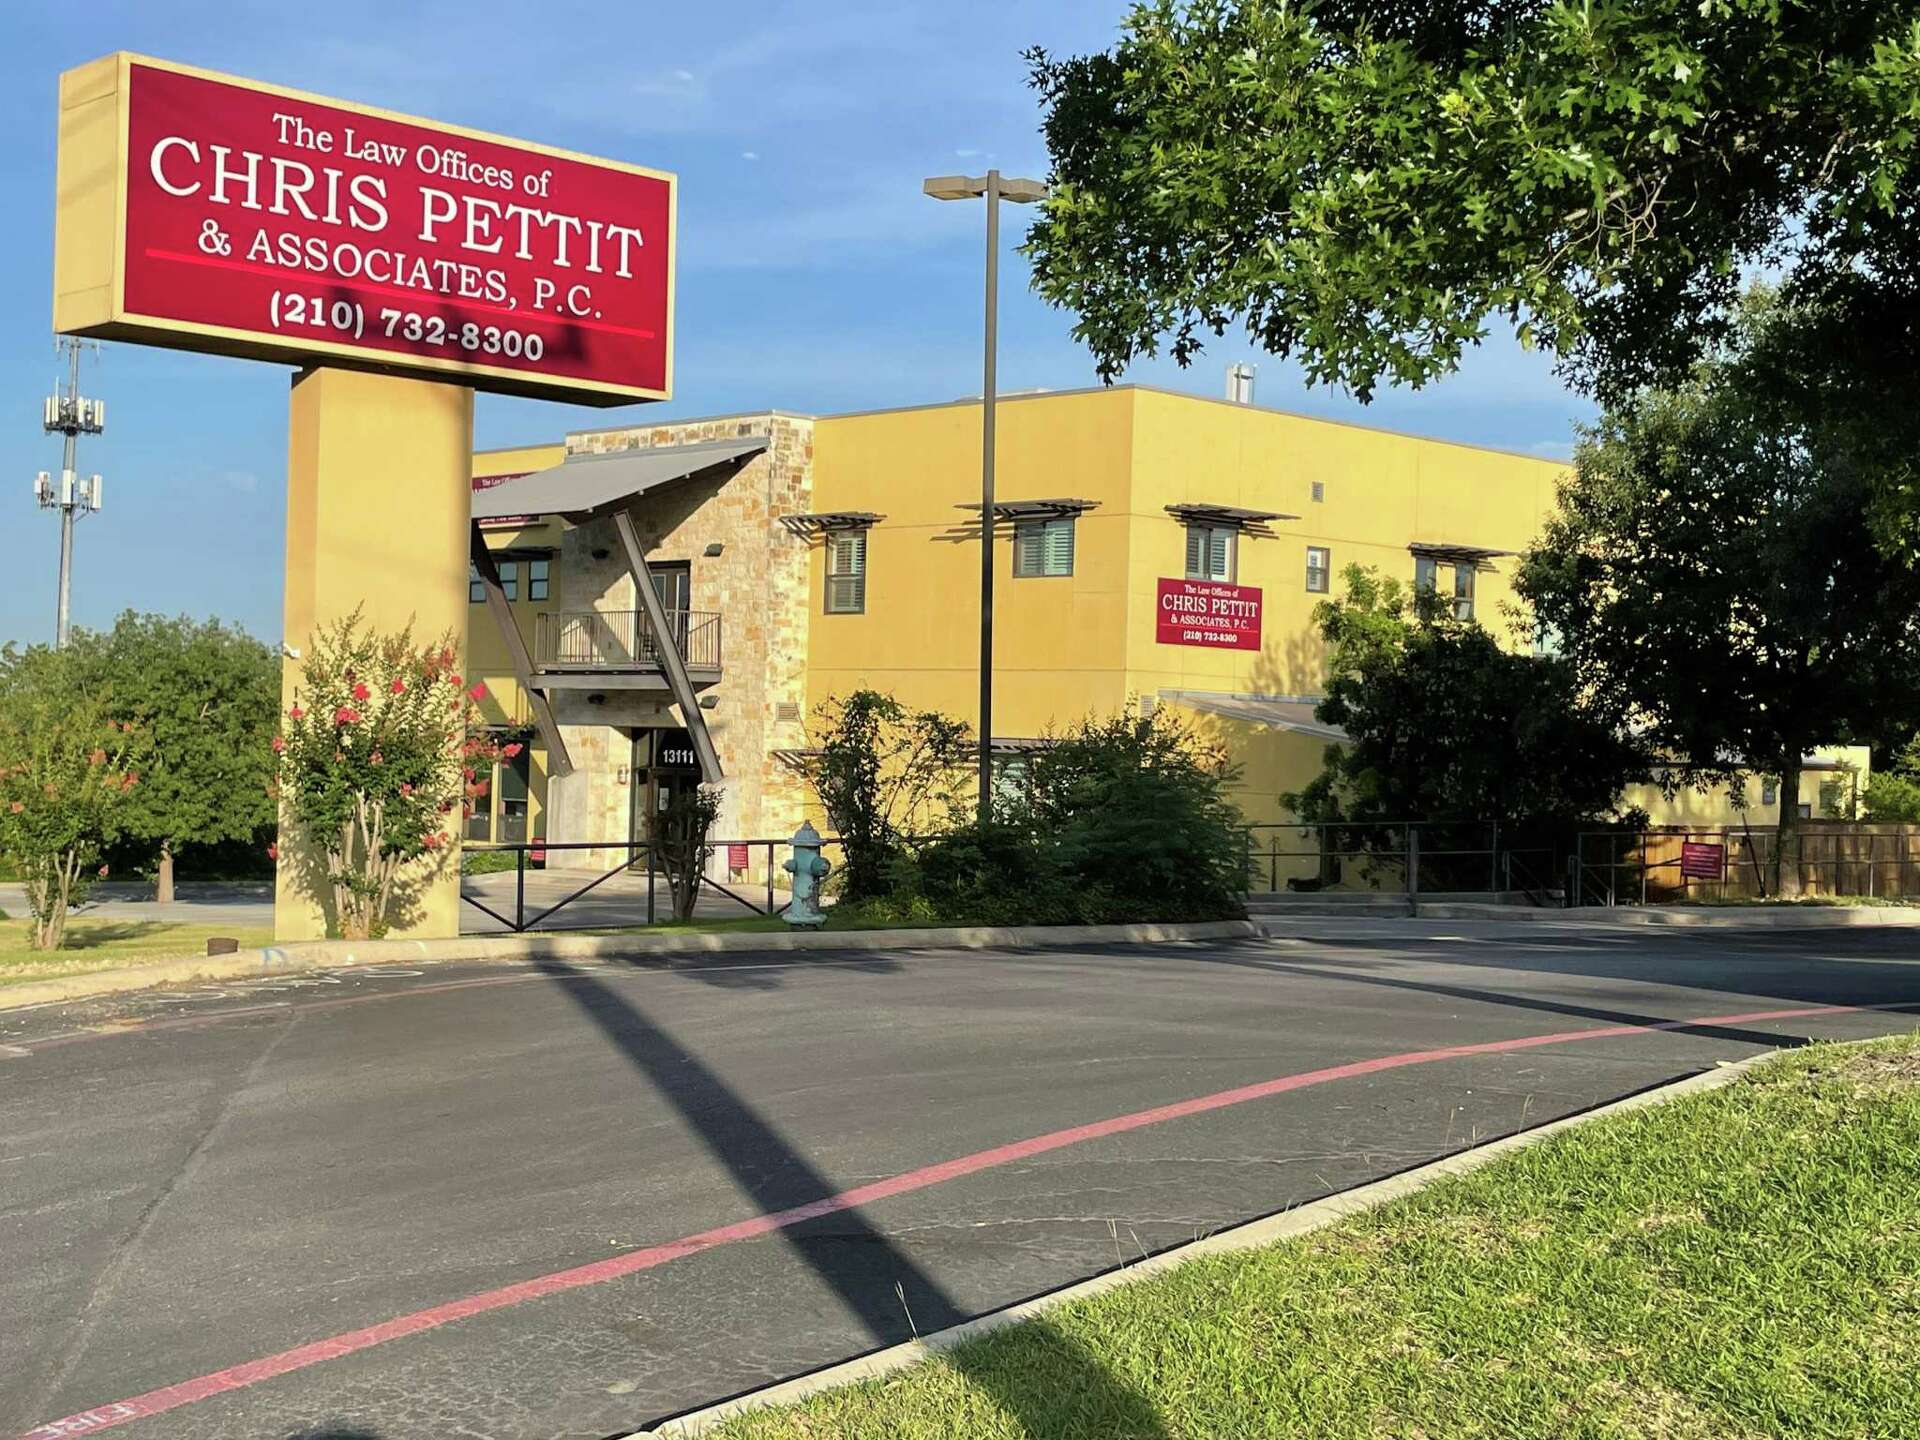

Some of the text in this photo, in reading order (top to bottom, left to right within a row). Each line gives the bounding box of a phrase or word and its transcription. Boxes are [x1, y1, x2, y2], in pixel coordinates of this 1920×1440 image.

[273, 113, 552, 197] The Law Offices of
[150, 136, 643, 278] CHRIS PETTIT
[198, 219, 602, 319] & ASSOCIATES, P.C.
[270, 290, 544, 361] (210) 732-8300
[1185, 584, 1196, 594] The
[1162, 594, 1258, 618] CHRIS PETTIT
[1170, 614, 1178, 624] &
[1183, 630, 1238, 643] (210) 732-8300
[663, 749, 694, 764] 13111
